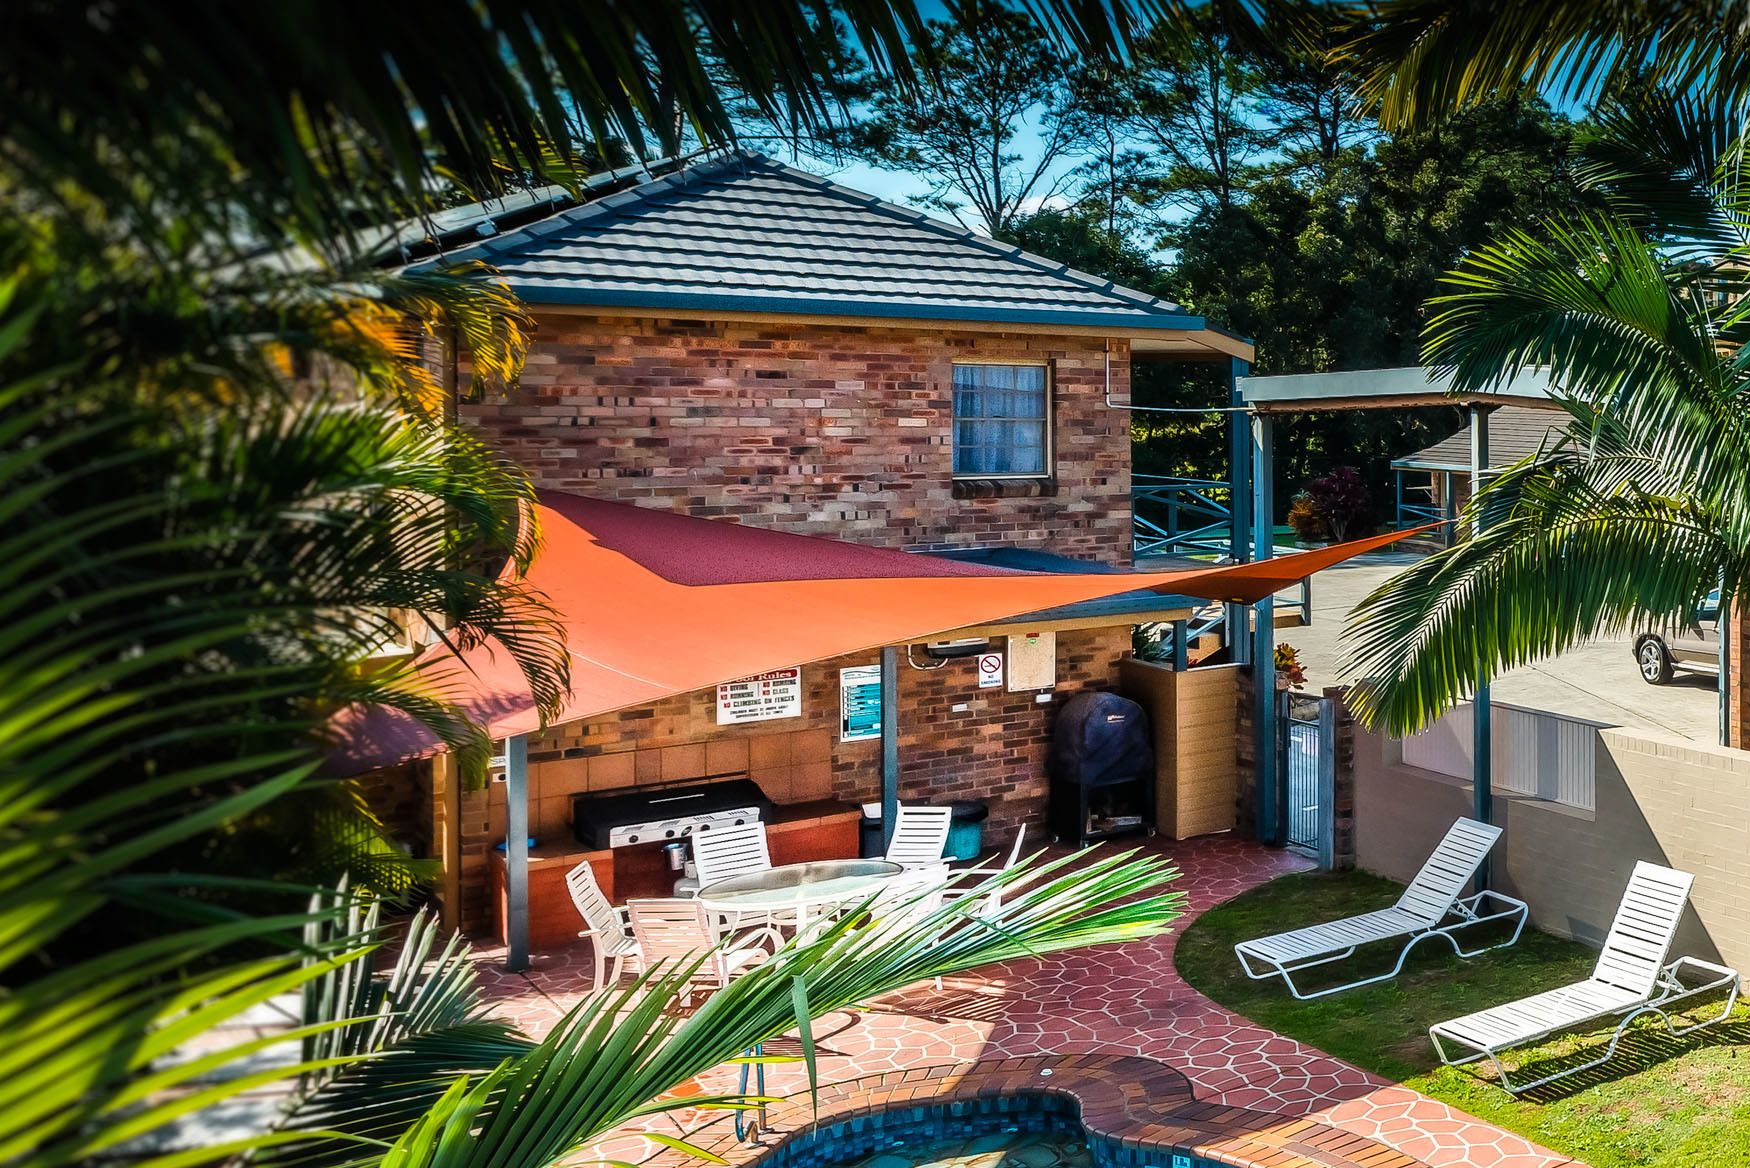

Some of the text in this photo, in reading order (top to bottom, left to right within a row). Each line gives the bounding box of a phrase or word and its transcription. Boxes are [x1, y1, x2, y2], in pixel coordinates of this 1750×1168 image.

[759, 672, 791, 680] Rules
[733, 699, 761, 707] CLIMBING
[774, 695, 795, 703] FENCES
